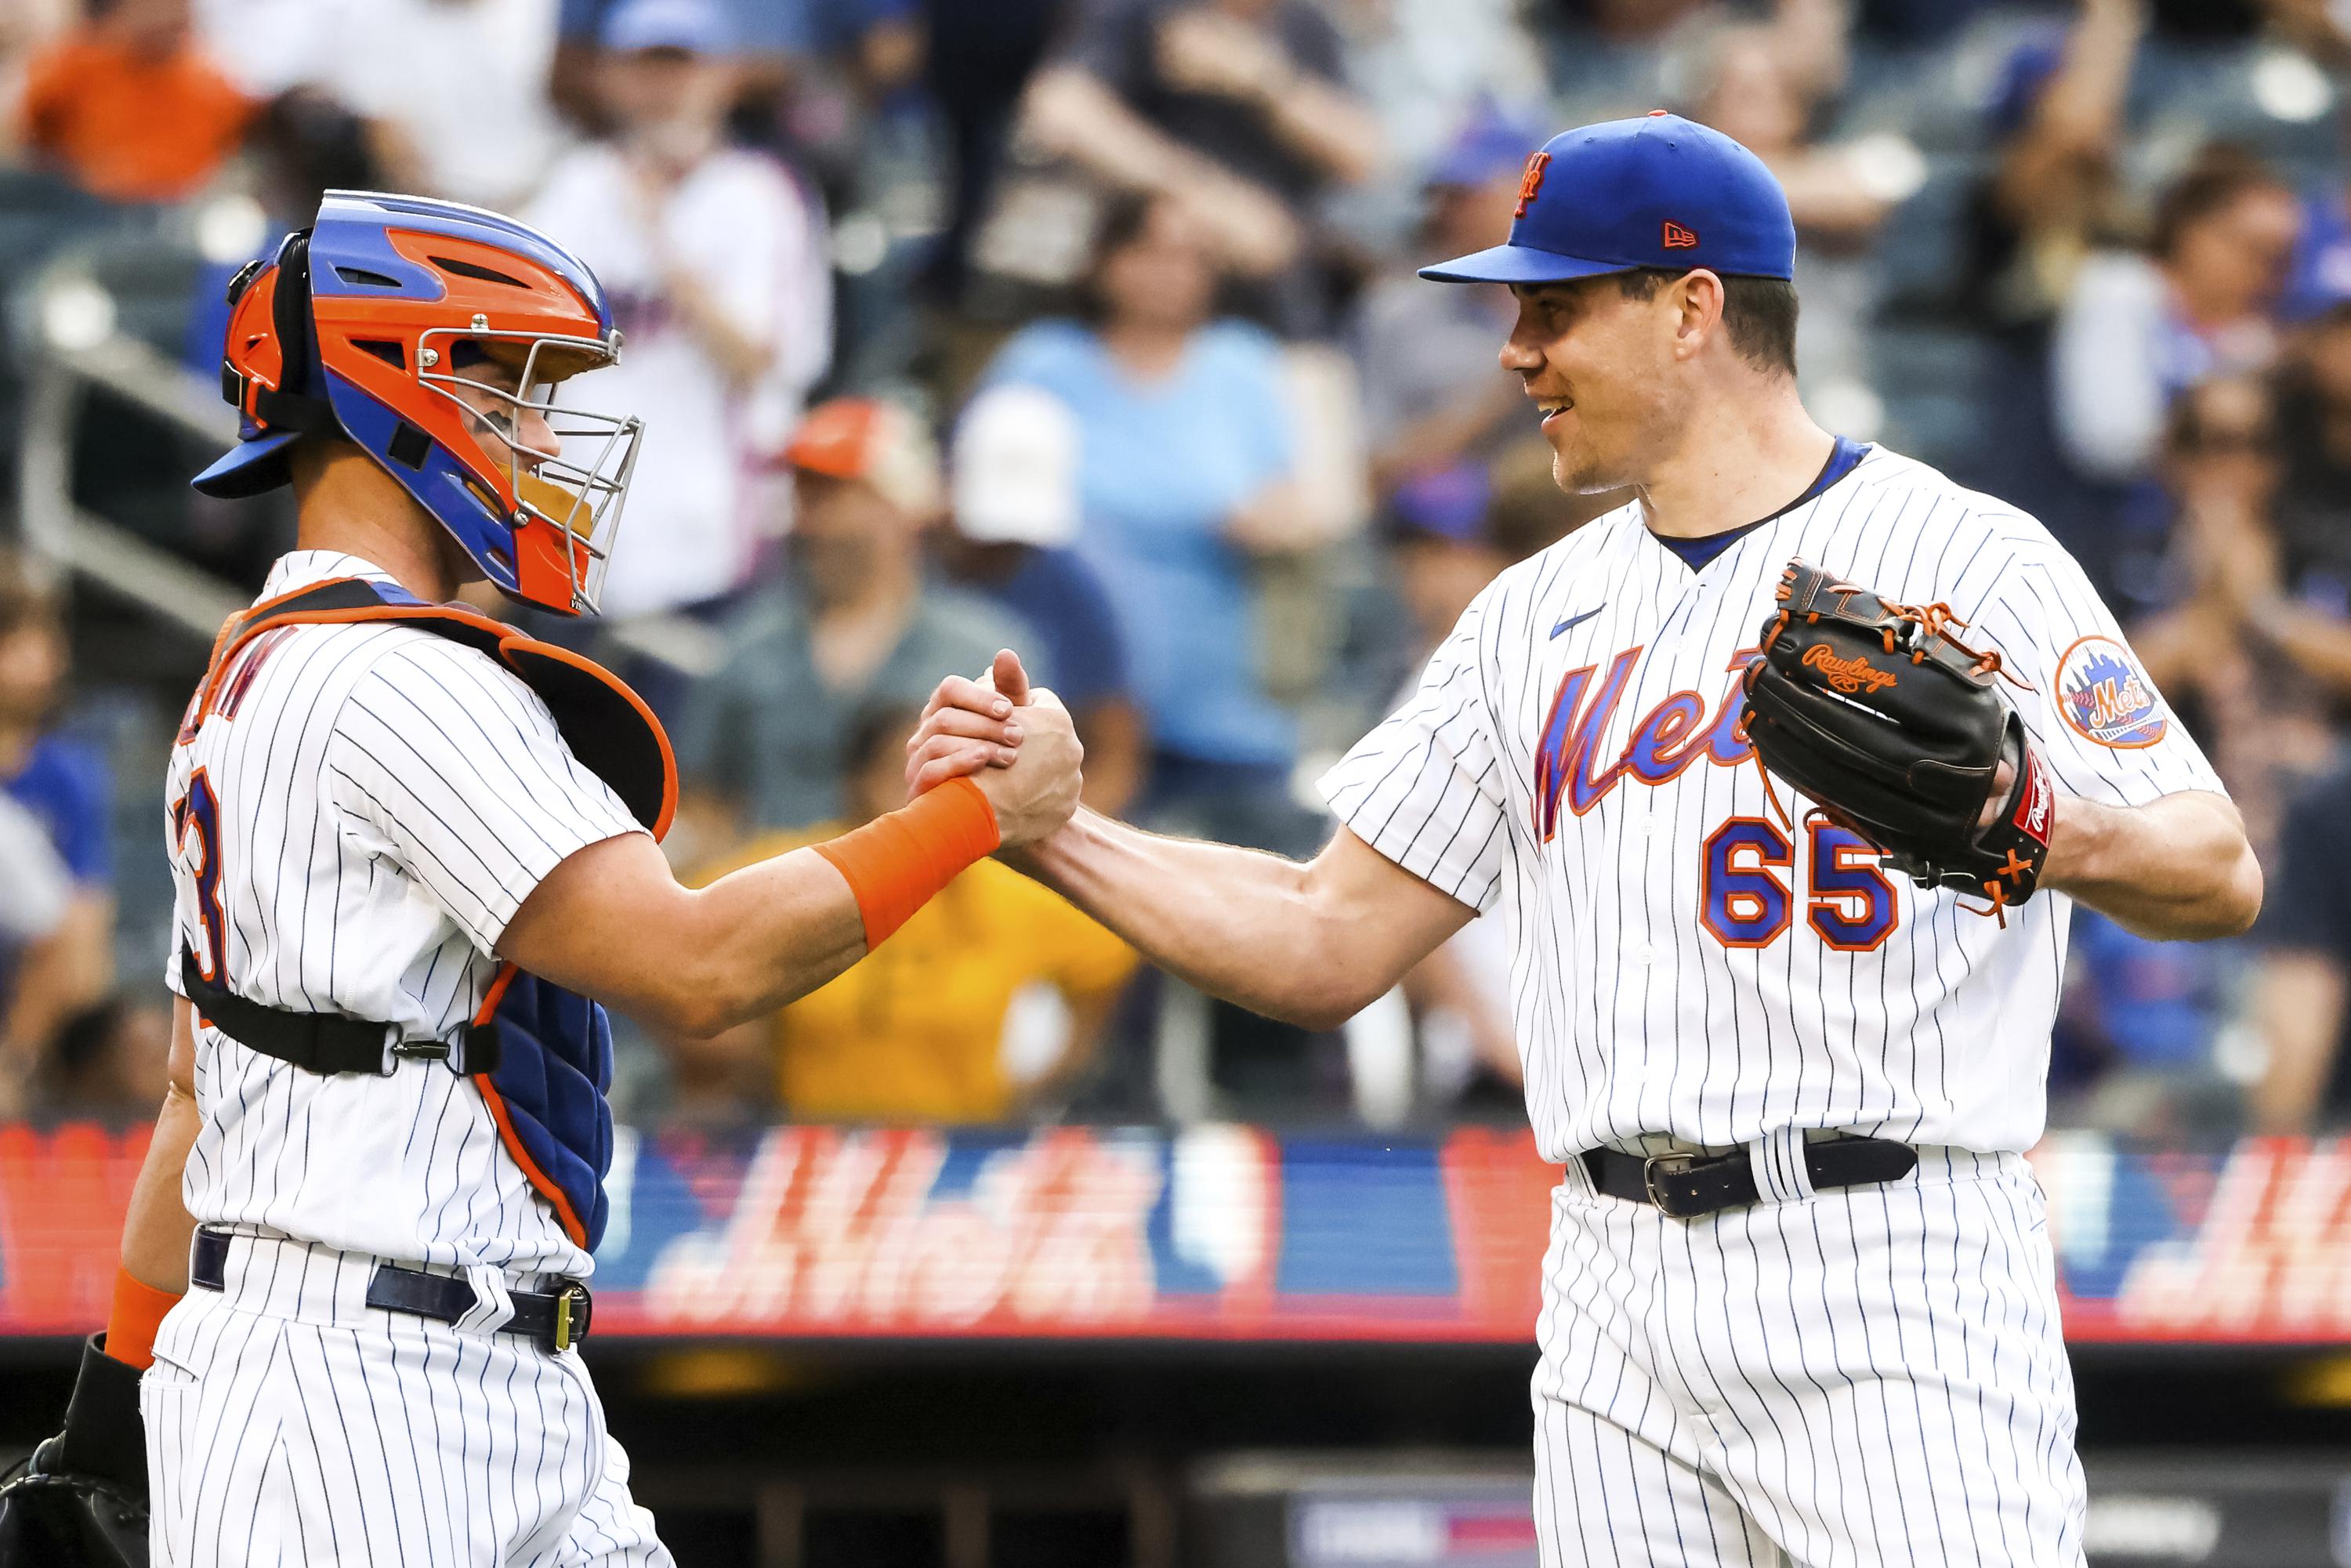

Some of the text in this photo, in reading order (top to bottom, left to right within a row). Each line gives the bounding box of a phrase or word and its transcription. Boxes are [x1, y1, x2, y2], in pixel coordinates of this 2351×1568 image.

[1802, 643, 1898, 693] Rawlings
[2088, 674, 2151, 729] Mets
[1531, 644, 1762, 846] Met
[1700, 815, 1899, 952] 65
